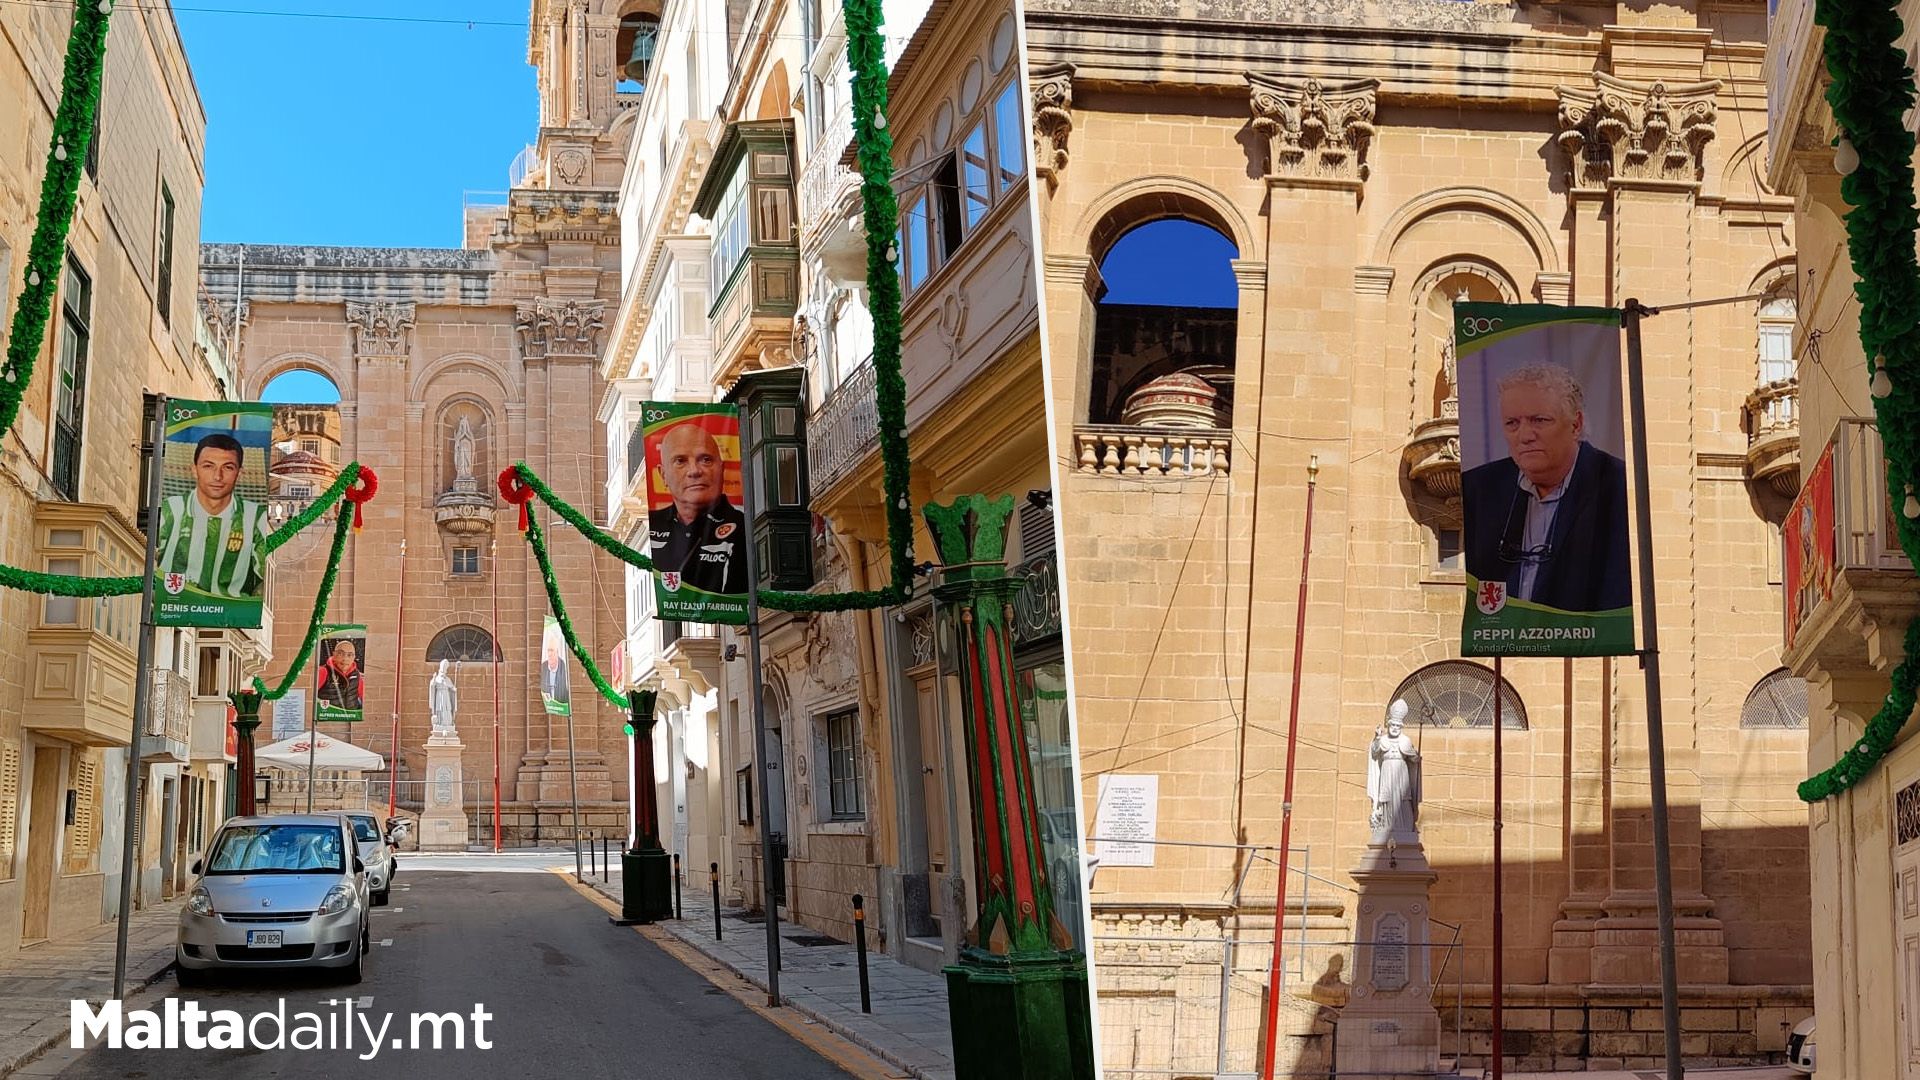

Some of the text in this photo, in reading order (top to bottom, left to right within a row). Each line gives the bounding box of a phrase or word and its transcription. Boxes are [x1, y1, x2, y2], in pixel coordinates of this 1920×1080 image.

[161, 603, 224, 614] DENIS CAUCHI
[663, 601, 679, 610] RAY
[706, 602, 743, 612] FARRUGIA
[1473, 627, 1596, 640] PEPPI AZZOPARDI
